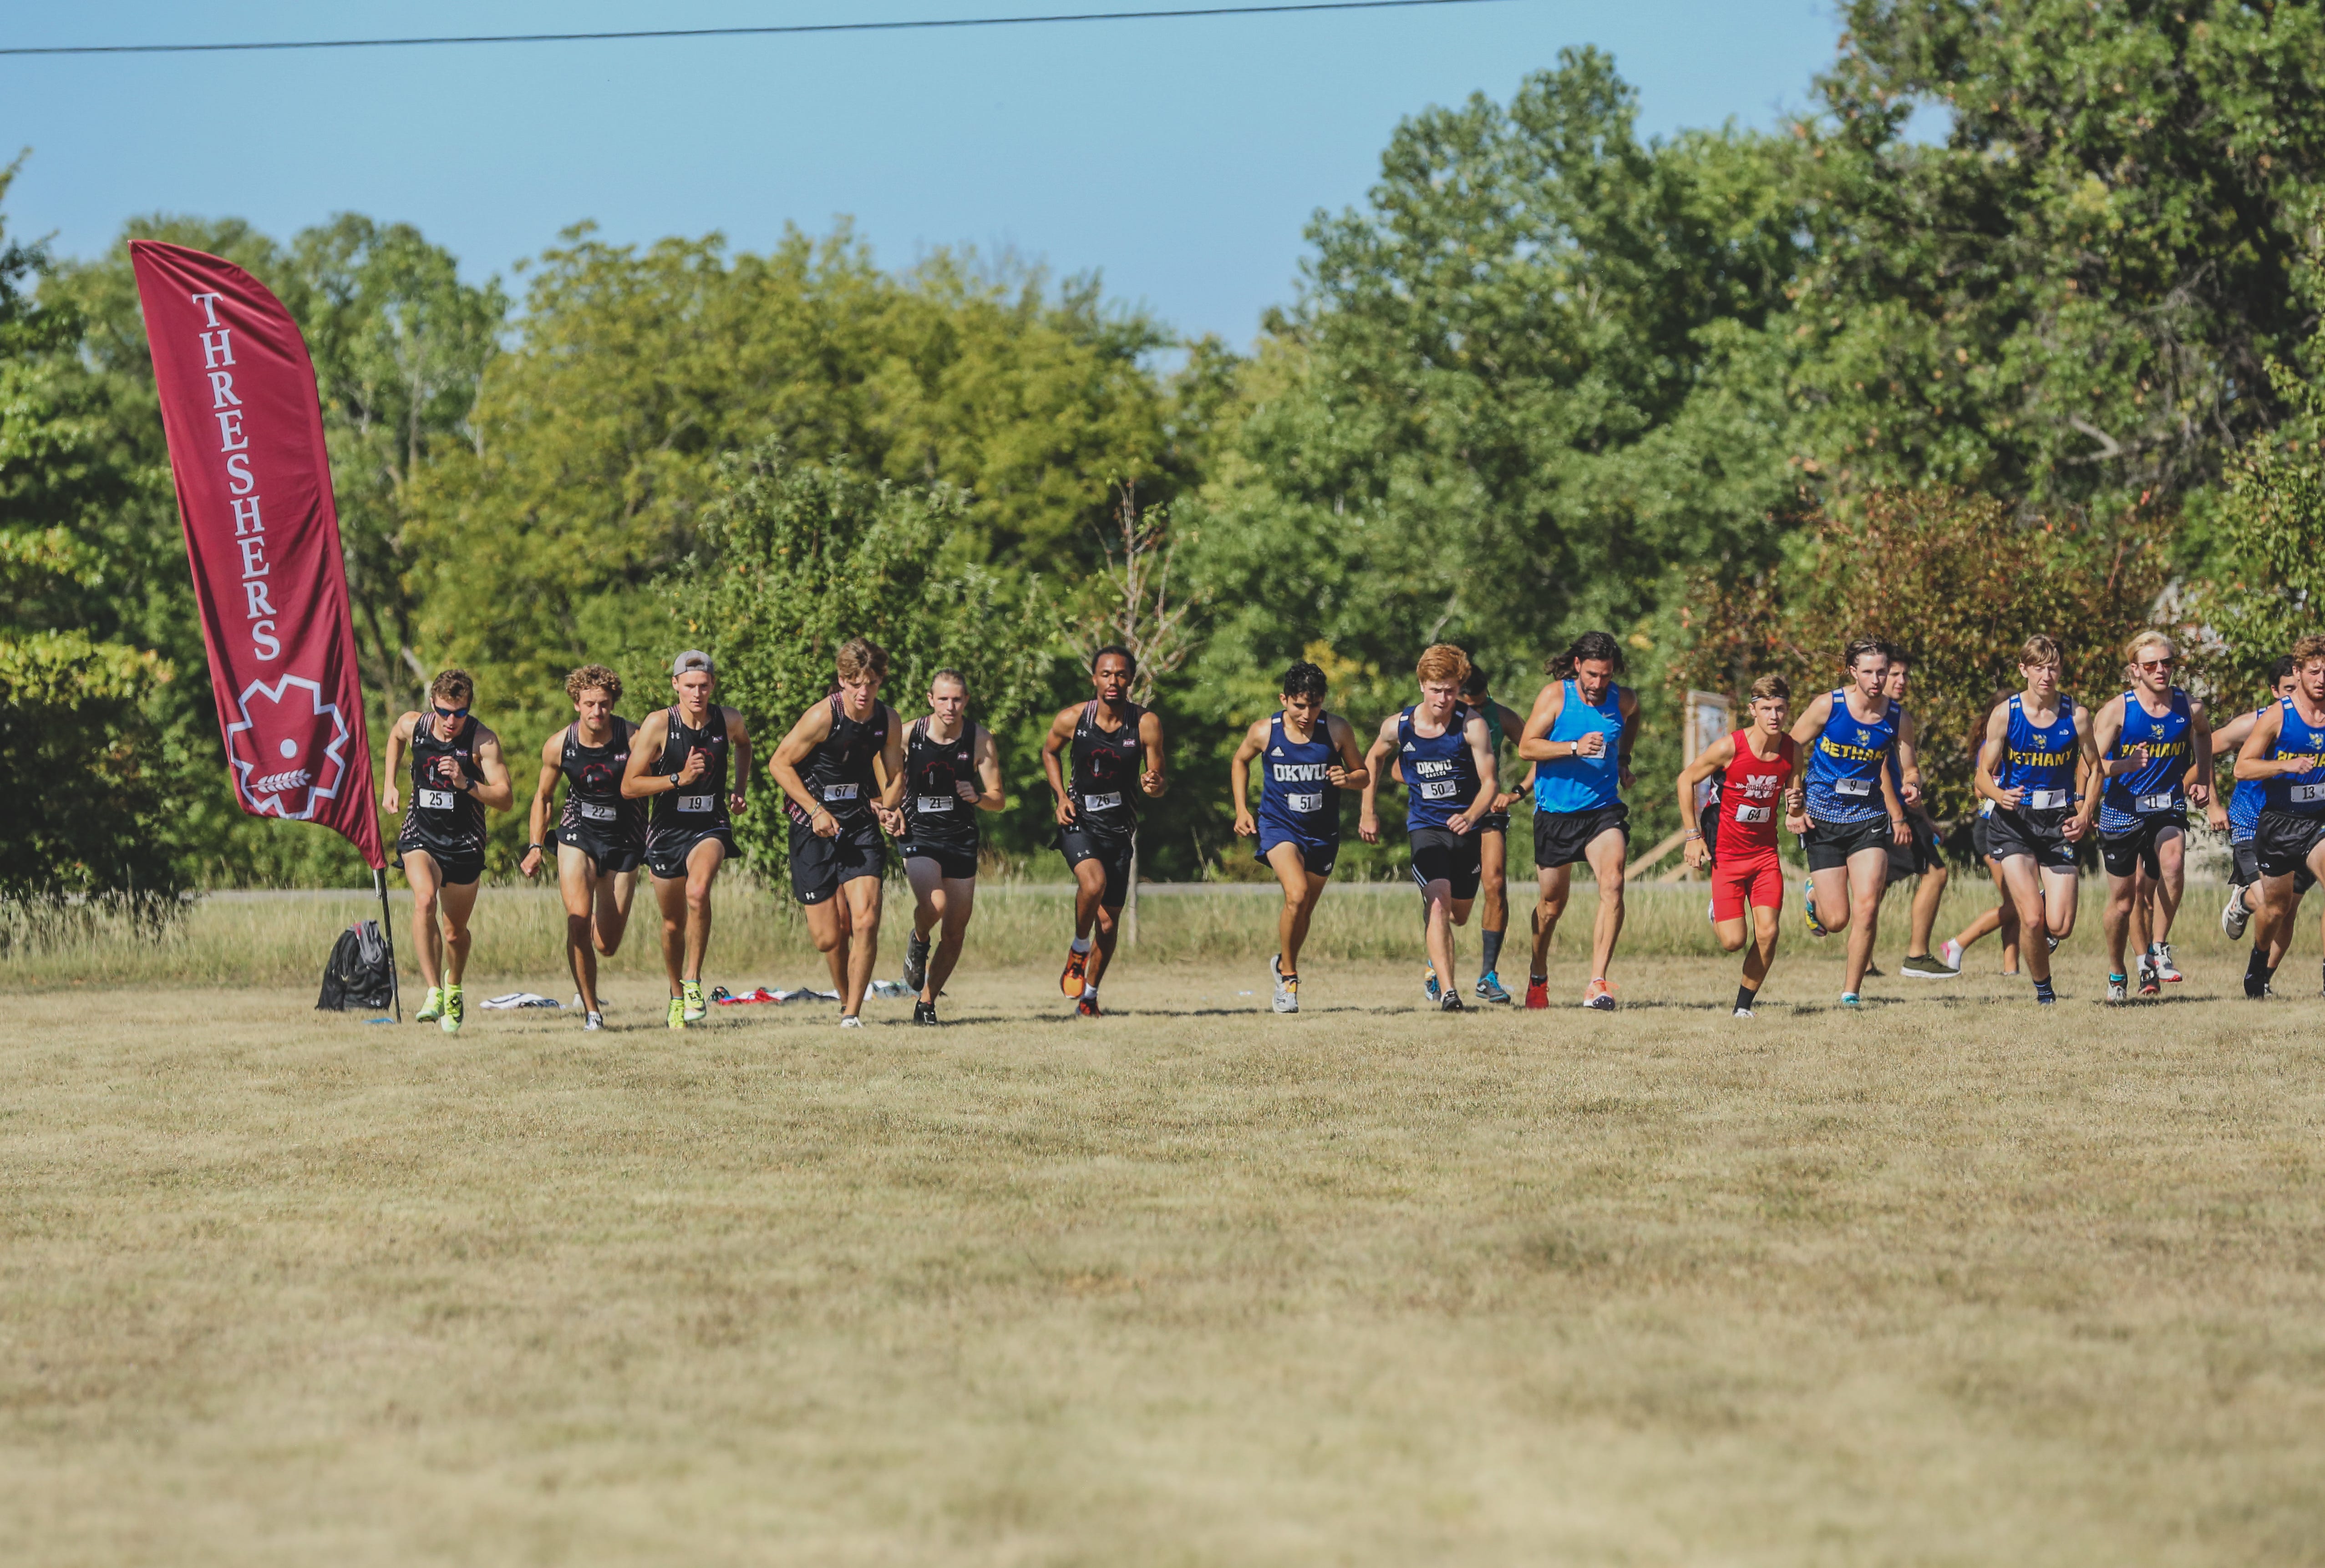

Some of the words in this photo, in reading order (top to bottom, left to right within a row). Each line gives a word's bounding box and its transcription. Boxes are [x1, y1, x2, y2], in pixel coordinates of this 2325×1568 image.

[192, 292, 280, 662] THRESHERS
[1820, 736, 1887, 761] BETHAN
[1273, 763, 1327, 782] OKWU
[1416, 759, 1452, 775] OKWU
[835, 785, 848, 797] 67
[1431, 783, 1445, 796] 50
[1743, 774, 1777, 798] XC
[1850, 780, 1857, 791] 9
[430, 792, 442, 806] 25
[2047, 792, 2054, 806] 7
[2302, 786, 2315, 799] 13
[689, 797, 702, 809] 19
[929, 798, 942, 809] 21
[1096, 795, 1110, 807] 26
[1300, 797, 1312, 810] 51
[2148, 796, 2159, 809] 11
[592, 806, 605, 817] 22
[1747, 809, 1761, 821] 64
